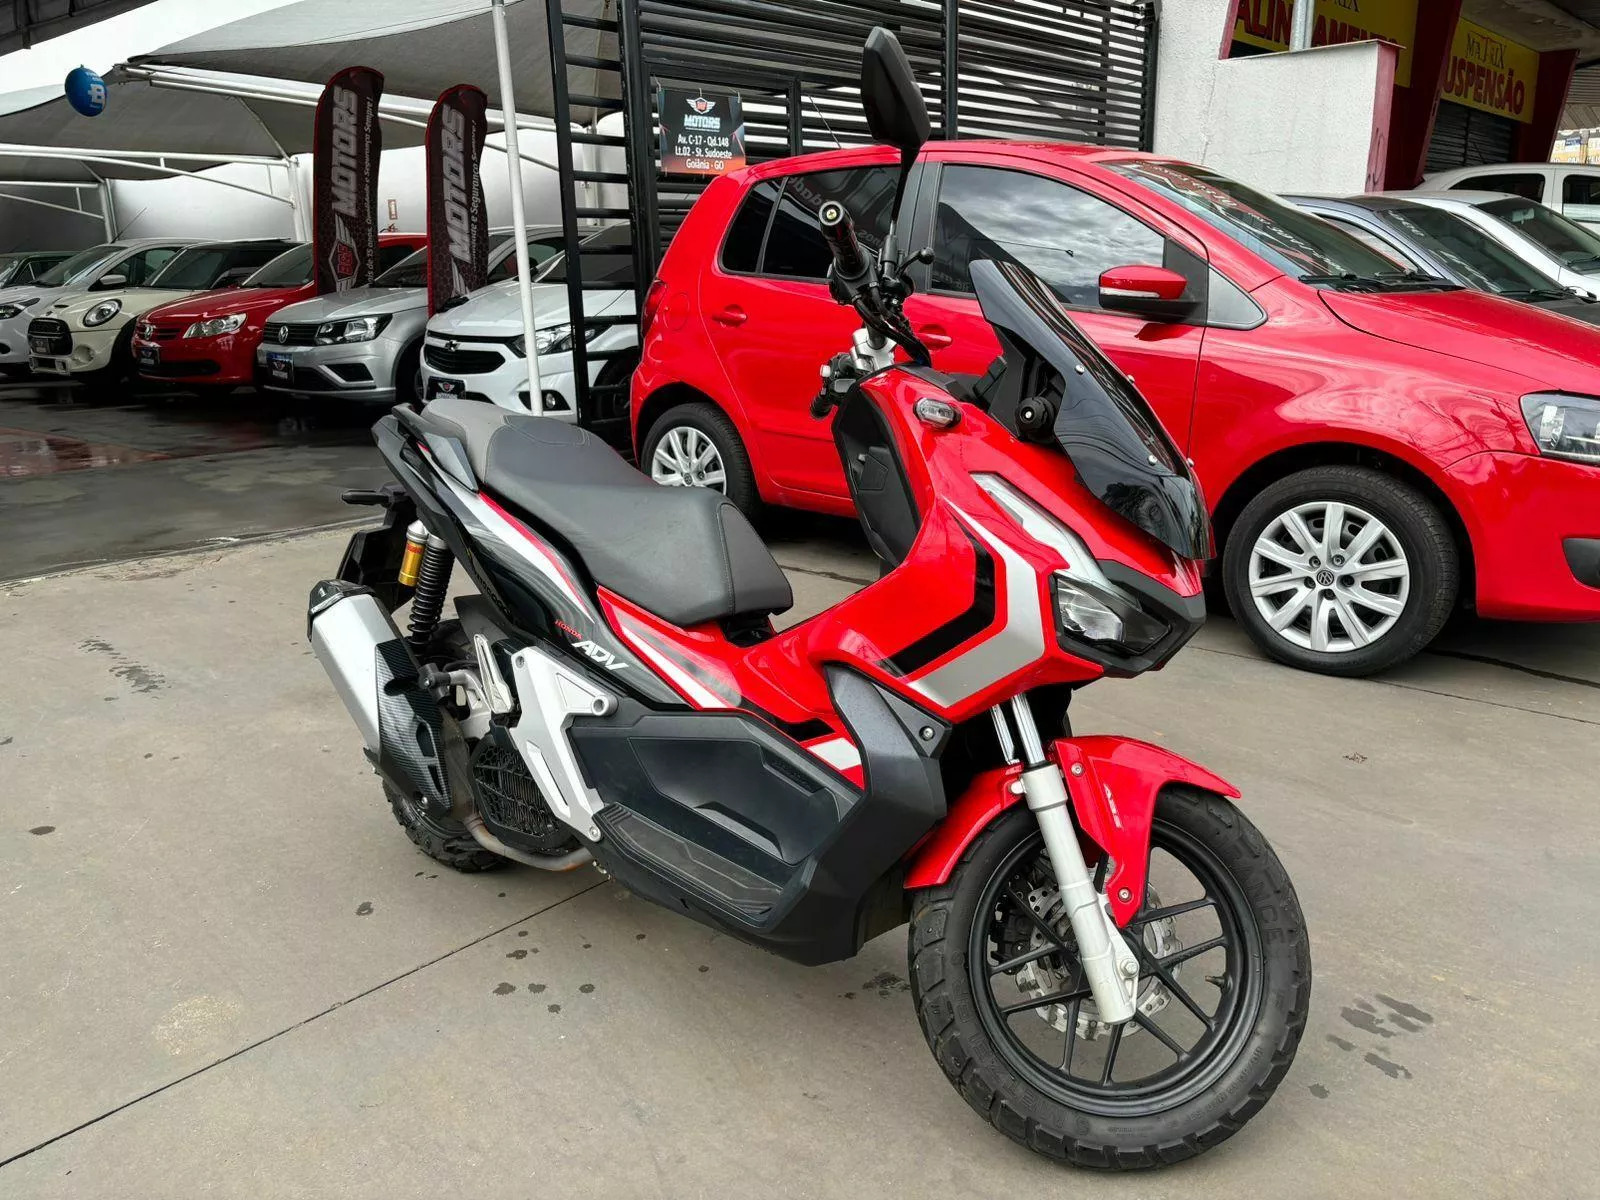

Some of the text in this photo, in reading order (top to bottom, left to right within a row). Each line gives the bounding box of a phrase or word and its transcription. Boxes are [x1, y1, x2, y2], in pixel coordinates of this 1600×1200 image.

[1443, 56, 1525, 114] USPENSÃO
[684, 114, 720, 129] MOTORS
[332, 85, 358, 218] MOTORS
[688, 135, 702, 145] C-17
[705, 148, 732, 159] Sudoeste
[714, 160, 724, 170] GO
[442, 104, 471, 262] MOTORS
[554, 618, 583, 641] HONDA
[571, 640, 629, 670] ADV
